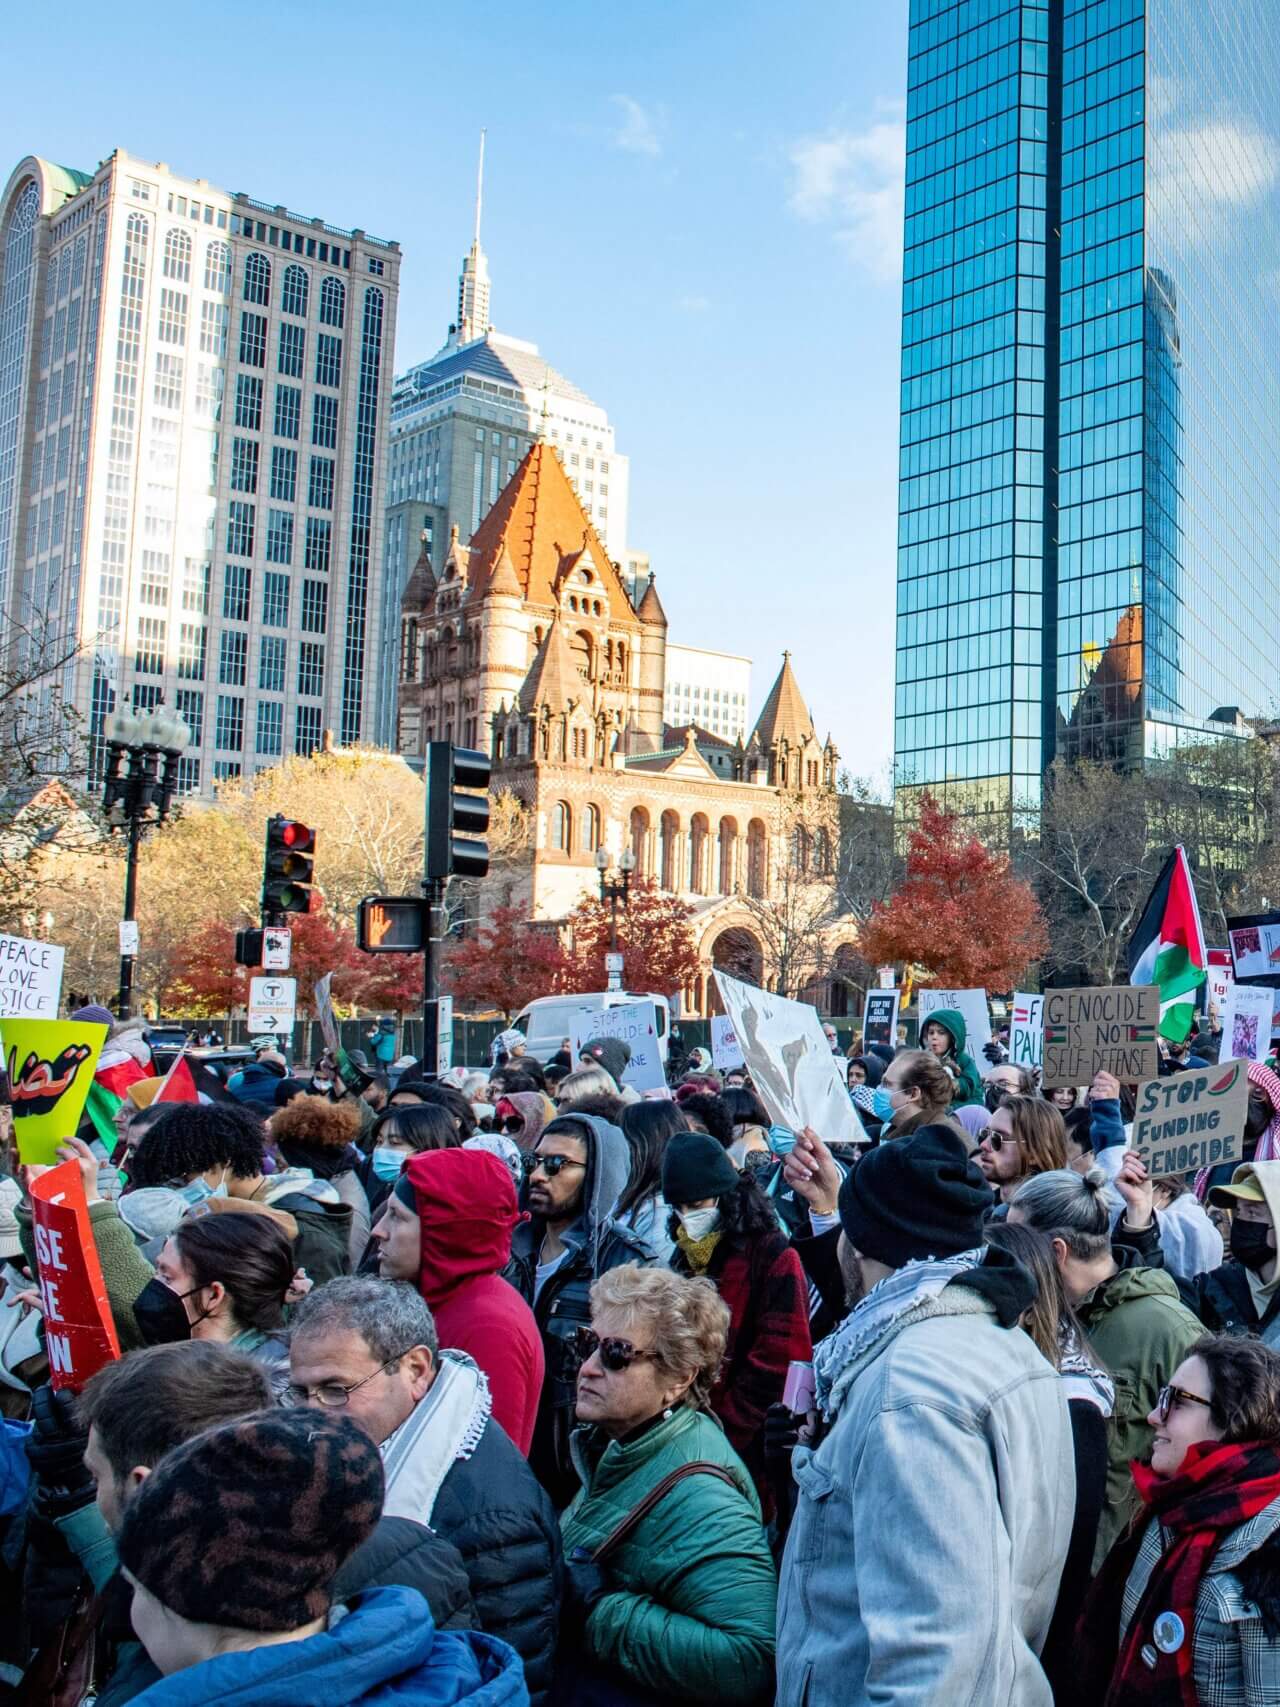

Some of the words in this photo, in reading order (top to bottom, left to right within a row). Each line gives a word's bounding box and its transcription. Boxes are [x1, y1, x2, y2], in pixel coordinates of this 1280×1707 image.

[621, 1007, 638, 1021] THE
[939, 992, 961, 1010] THE
[1048, 991, 1148, 1024] GENOCIDE
[1067, 1025, 1081, 1047] IS
[1096, 1025, 1132, 1045] NOT
[1045, 1047, 1149, 1079] SELF-DEFENSE
[1139, 1077, 1208, 1113] STOP
[1137, 1110, 1220, 1145] FUNDING
[1139, 1135, 1236, 1174] GENOCIDE
